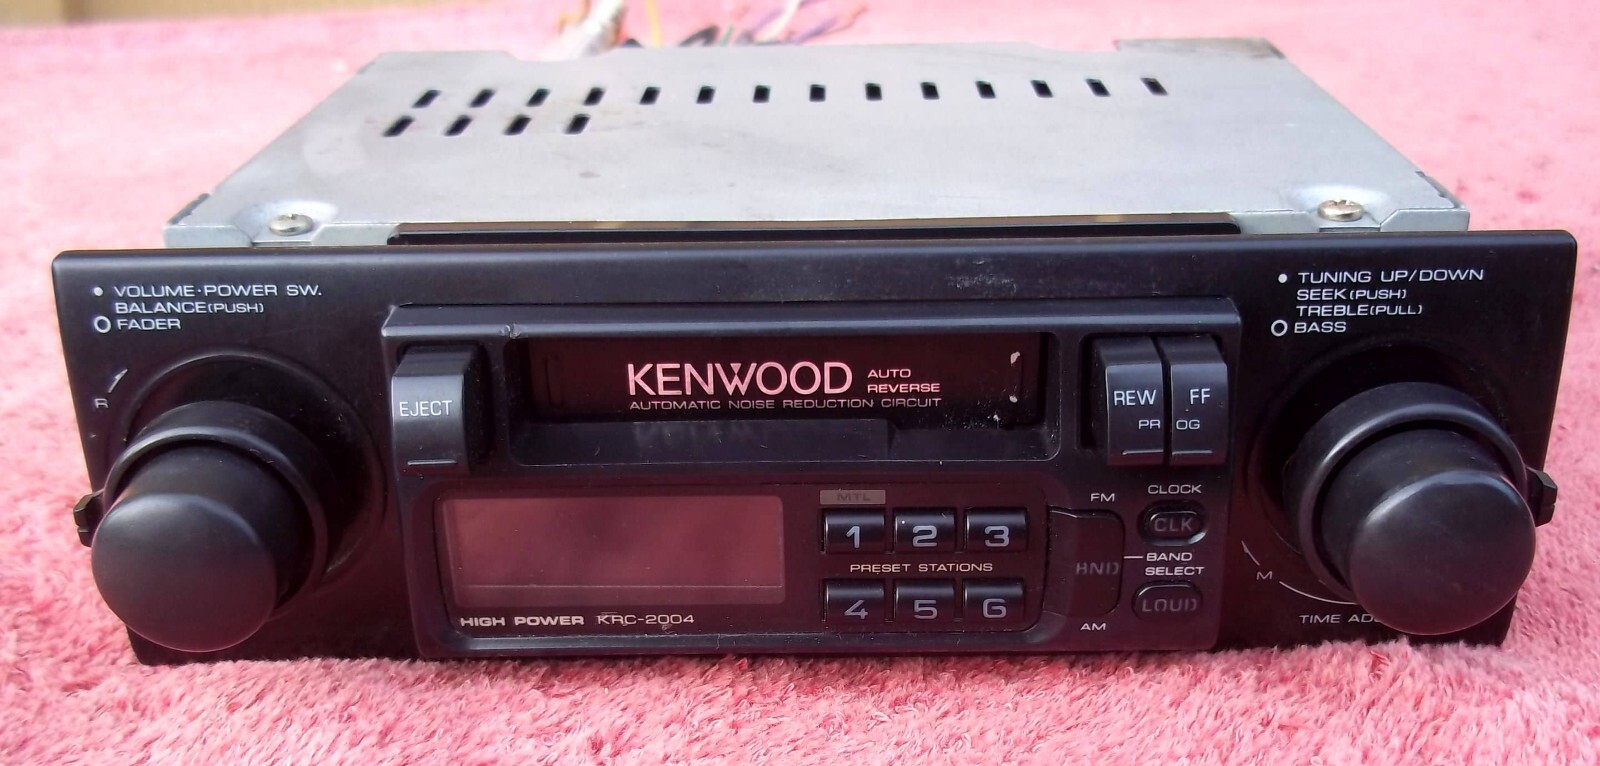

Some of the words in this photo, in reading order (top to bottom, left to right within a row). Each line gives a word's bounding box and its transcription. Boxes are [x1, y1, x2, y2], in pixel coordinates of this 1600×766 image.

[1298, 271, 1372, 284] TUNING
[1381, 269, 1484, 283] UP/DOWN
[286, 284, 322, 297] SW.
[117, 318, 181, 330] FADER
[1294, 322, 1347, 334] BASS
[627, 361, 853, 396] KENWOOD
[867, 368, 912, 379] AUTO
[867, 383, 941, 394] REVERSE
[1113, 389, 1157, 406] REW
[1189, 388, 1211, 405] FF
[94, 398, 109, 409] R
[399, 400, 453, 417] EJECT
[629, 400, 721, 411] AUTOMATIC
[728, 400, 775, 410] NOISE
[783, 399, 874, 409] REDUCTION
[881, 398, 942, 408] CIRCUIT
[1147, 484, 1203, 495] CLOCK
[837, 493, 871, 502] MTL
[1090, 493, 1116, 503] FM
[1153, 517, 1194, 533] CLK
[845, 525, 861, 549] 1
[912, 525, 938, 547] 2
[984, 525, 1010, 547] 3
[1146, 552, 1193, 562] BAND
[850, 563, 911, 573] PRESET
[918, 562, 993, 572] STATIONS
[1144, 566, 1205, 576] SELECT
[1256, 570, 1273, 580] M
[844, 599, 869, 620] 4
[913, 599, 938, 620] 5
[982, 598, 1007, 618] 6
[1141, 598, 1197, 613] LOUD
[460, 616, 506, 627] HIGH
[513, 615, 585, 626] POWER
[596, 613, 695, 626] KRC-2004
[1299, 614, 1341, 624] TIME
[1347, 613, 1382, 623] AD
[1080, 622, 1107, 631] AM
